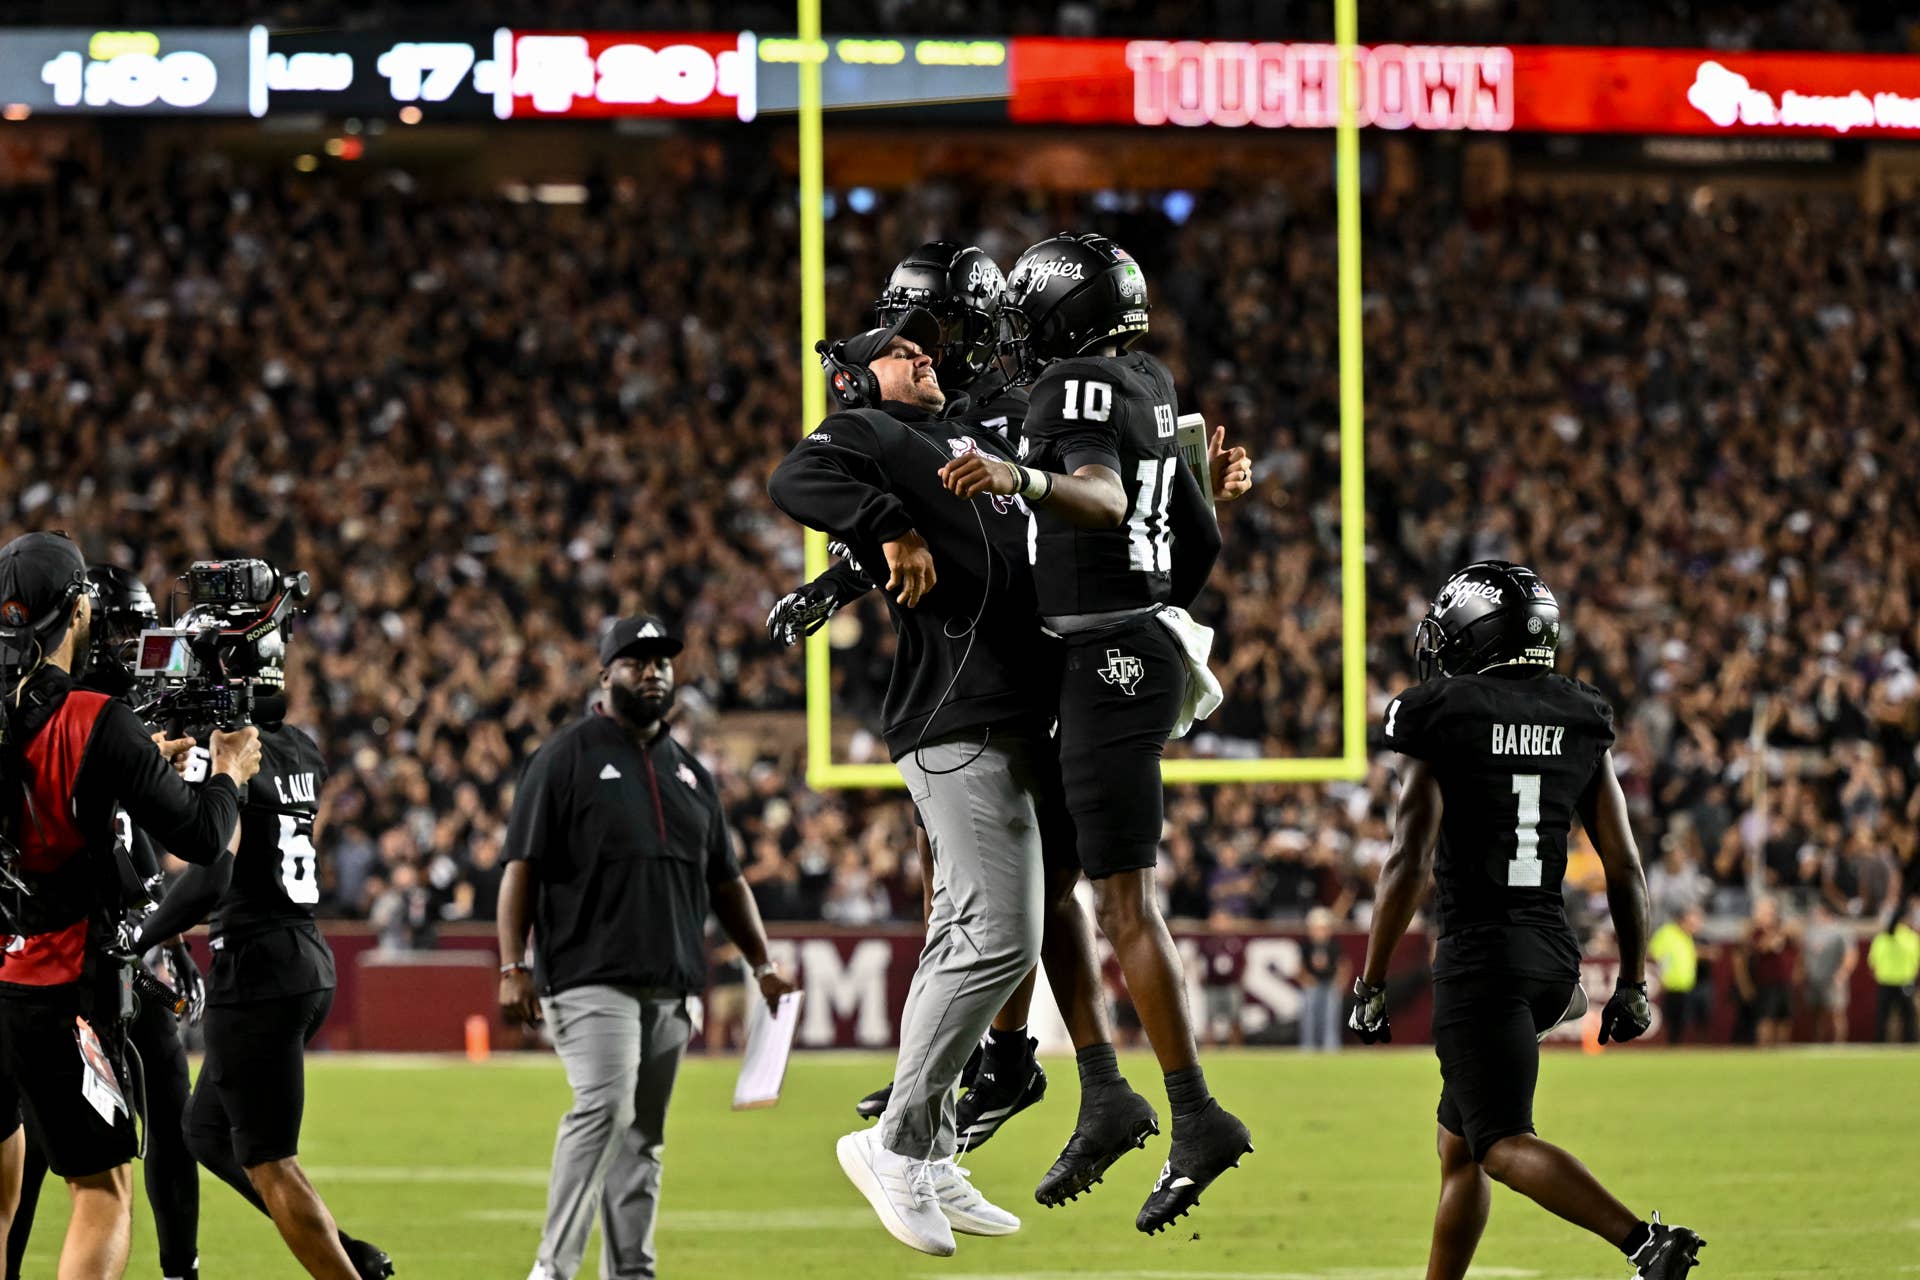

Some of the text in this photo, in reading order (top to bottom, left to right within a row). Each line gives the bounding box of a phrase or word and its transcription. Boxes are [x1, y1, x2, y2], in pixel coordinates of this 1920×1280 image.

[377, 43, 475, 101] 17
[595, 44, 717, 104] 20
[1062, 380, 1112, 422] 10
[246, 620, 276, 641] RONIN
[1492, 723, 1565, 755] BARBER
[1508, 774, 1542, 886] 1
